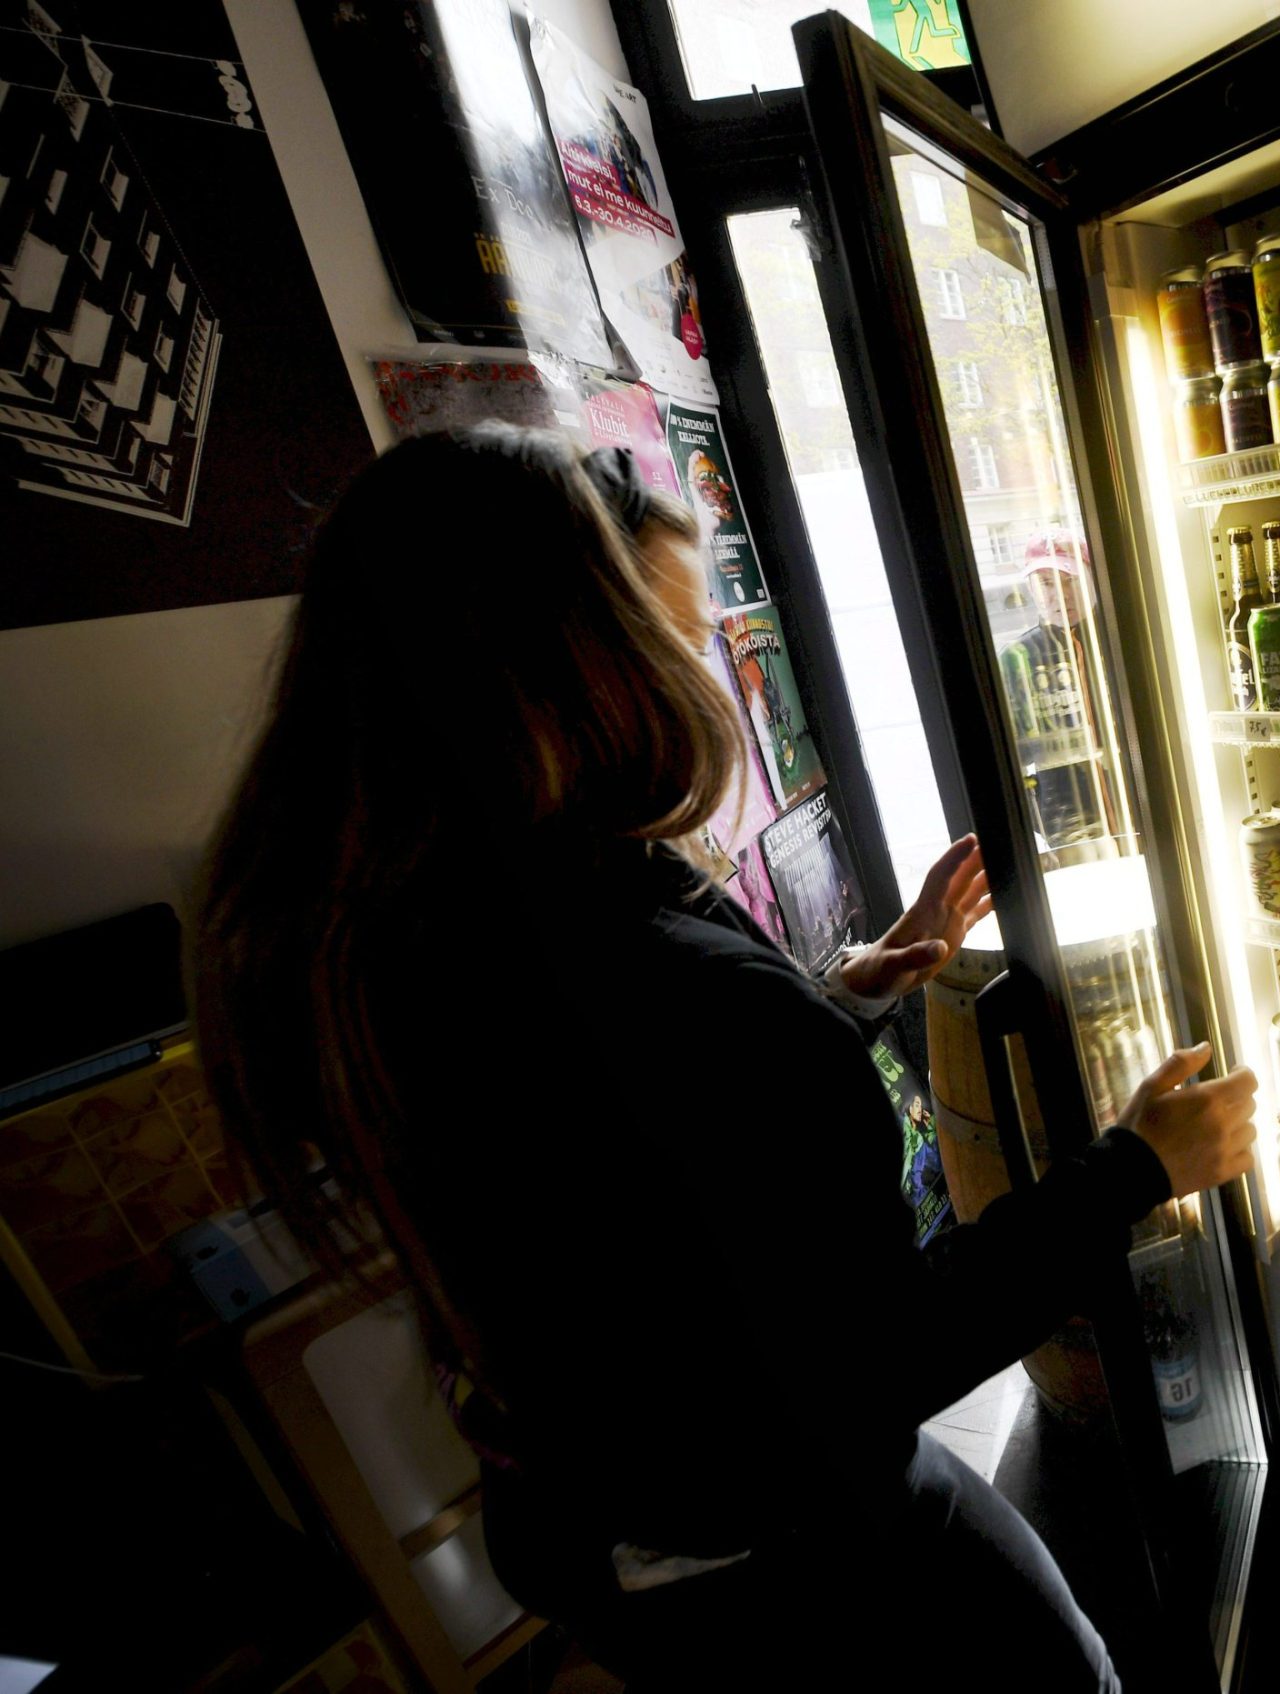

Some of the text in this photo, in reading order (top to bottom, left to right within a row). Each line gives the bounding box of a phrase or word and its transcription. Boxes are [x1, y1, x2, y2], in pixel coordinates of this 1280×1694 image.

[568, 169, 593, 192] mut
[594, 181, 604, 197] ei
[606, 189, 625, 205] me
[589, 407, 630, 437] Klubit
[764, 816, 795, 851] STEVE
[769, 835, 803, 869] GENESIS
